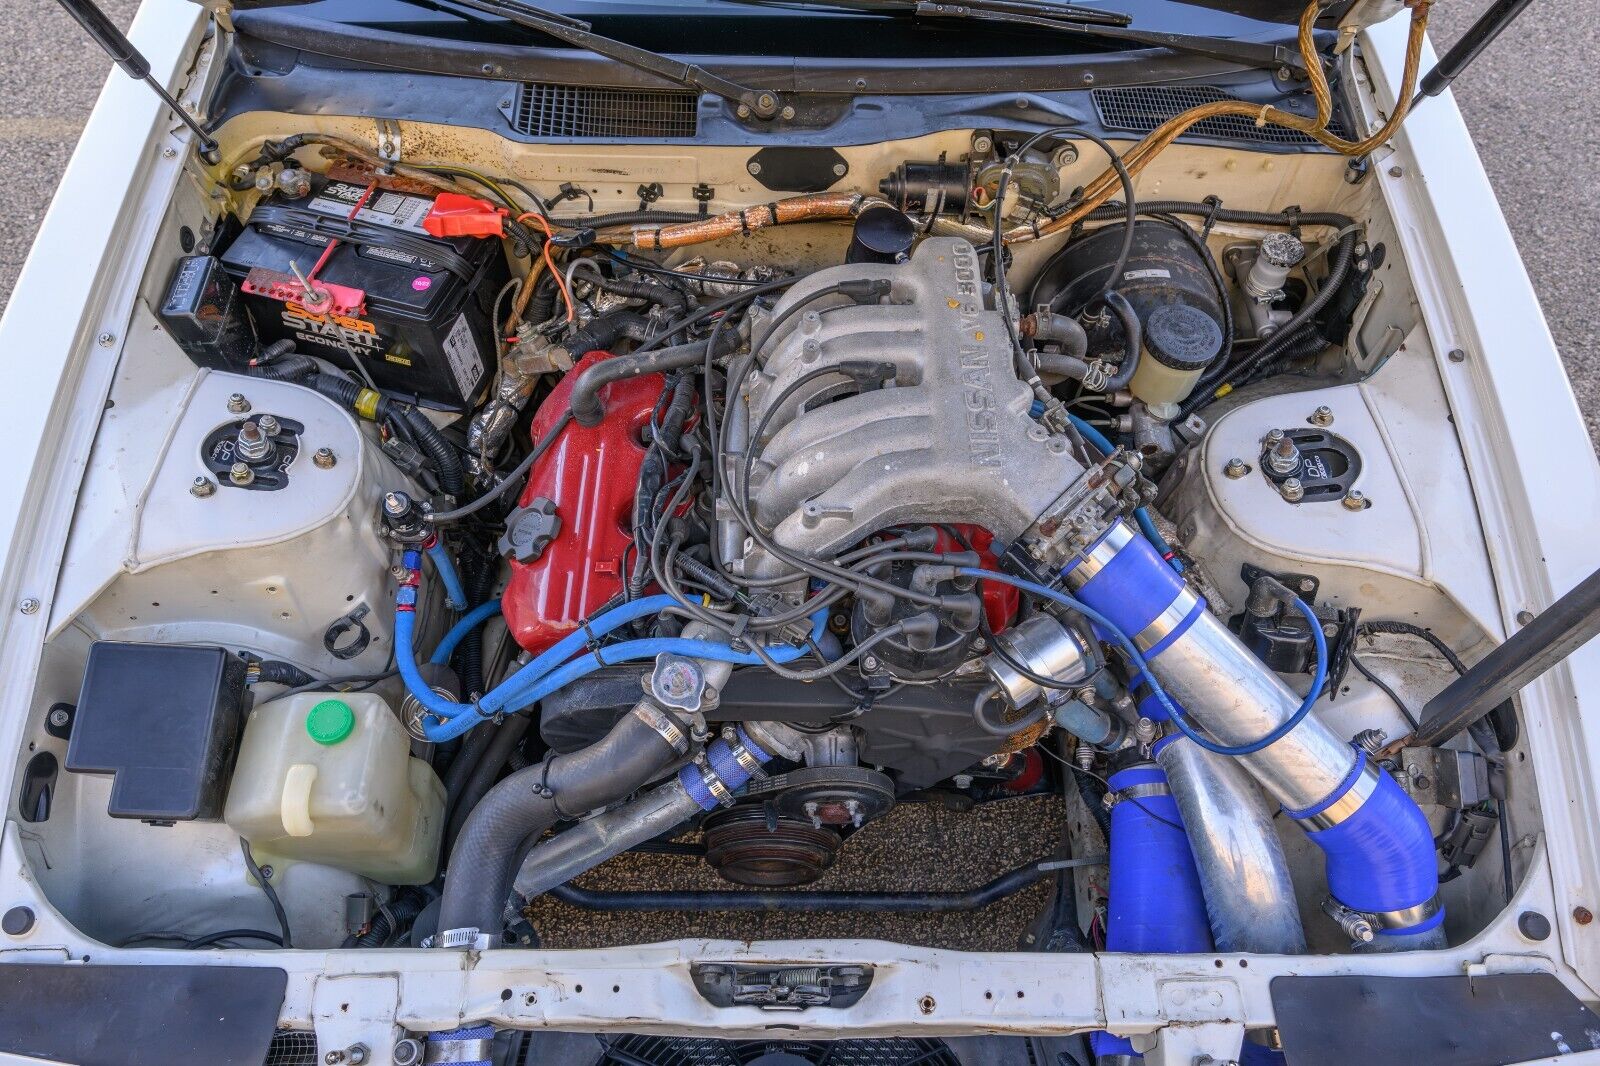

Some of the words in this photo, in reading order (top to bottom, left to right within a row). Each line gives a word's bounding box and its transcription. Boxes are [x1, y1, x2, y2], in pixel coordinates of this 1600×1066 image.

[953, 243, 977, 296] 3000
[959, 303, 980, 332] V6
[959, 345, 1003, 467] NISSAN
[1304, 458, 1320, 477] DP
